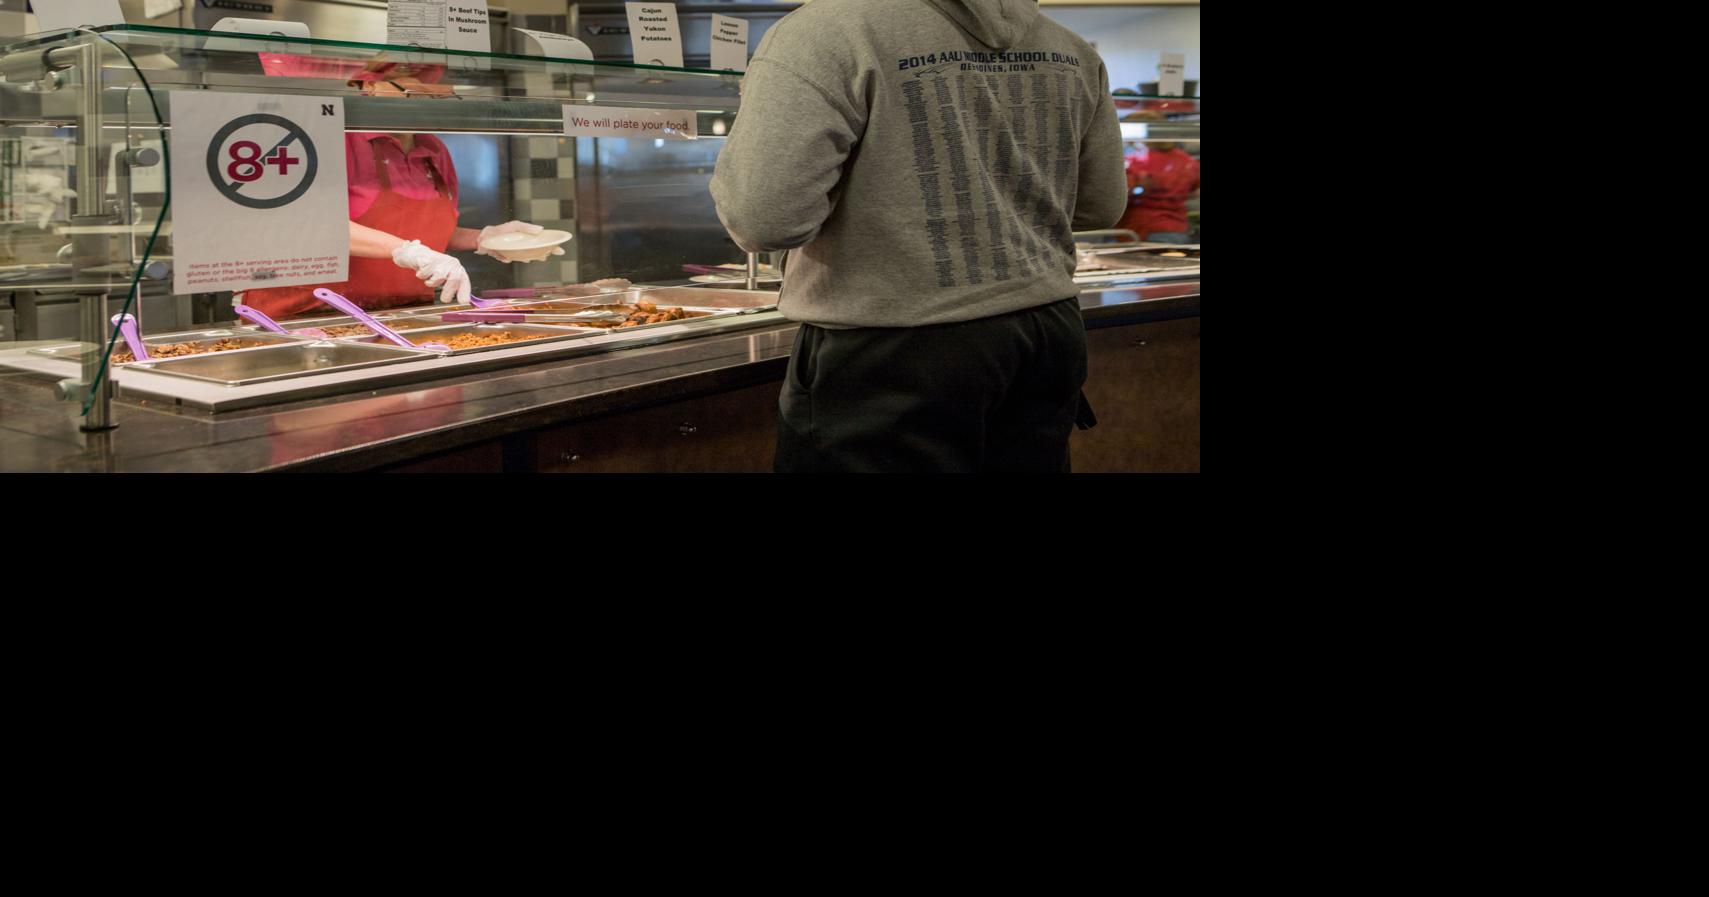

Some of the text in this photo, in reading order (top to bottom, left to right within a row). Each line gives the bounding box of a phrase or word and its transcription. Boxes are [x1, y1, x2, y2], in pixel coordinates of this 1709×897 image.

[456, 16, 486, 24] Mushroom
[898, 54, 936, 70] 2014
[939, 51, 962, 63] AAU
[998, 52, 1049, 63] SCHOOL
[1009, 64, 1036, 72] IOWA
[321, 104, 335, 116] N
[572, 117, 590, 127] We
[592, 118, 610, 128] will
[614, 119, 639, 130] plate
[641, 121, 663, 131] your
[228, 140, 299, 182] 8+
[236, 267, 248, 275] big
